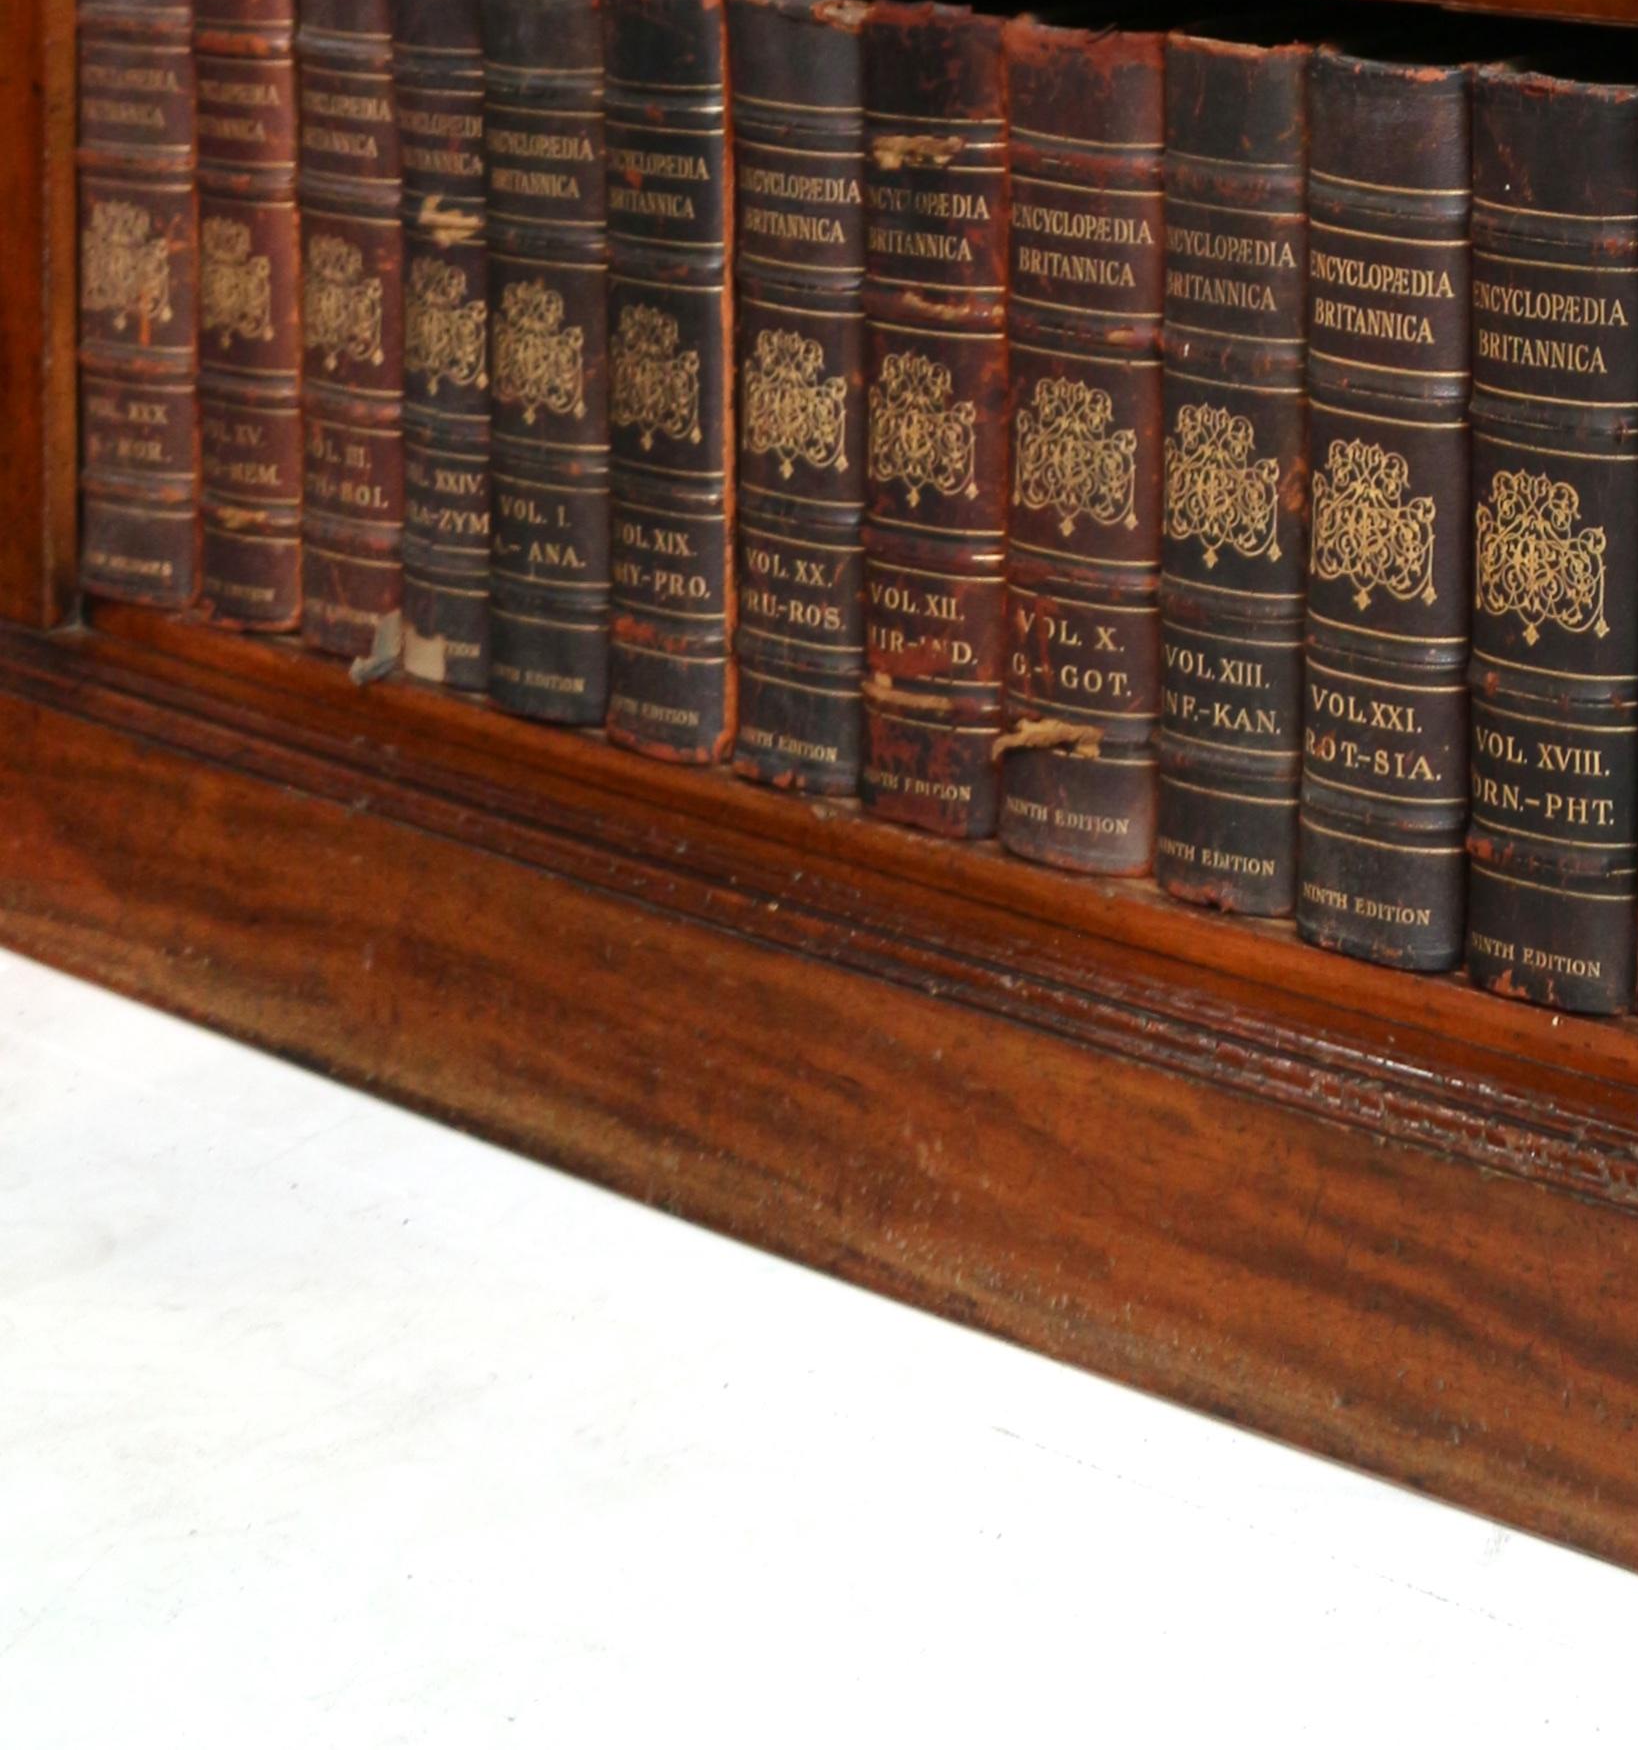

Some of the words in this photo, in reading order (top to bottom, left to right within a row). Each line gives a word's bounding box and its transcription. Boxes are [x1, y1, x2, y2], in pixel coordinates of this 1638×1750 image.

[1012, 202, 1155, 246] ENCYCLOPÆDIA
[1018, 247, 1136, 289] BRITANNICA
[1167, 226, 1297, 269] NCYCLOPÆDIA
[1166, 268, 1278, 312] BRITANNICA
[1310, 249, 1455, 299] ENCYCLOPÆDIA
[1313, 297, 1436, 345] BRITANNICA
[1473, 279, 1629, 328] ENCYCLOPÆDIA
[1477, 330, 1608, 375] BRITANNICA
[653, 528, 698, 558] XIX.
[746, 546, 788, 580] VOL.
[794, 559, 833, 589] XX.
[745, 587, 848, 632] RU.-ROS.
[869, 581, 921, 615] VOL.
[923, 593, 966, 622] XII.
[1093, 626, 1126, 652] X.
[1165, 644, 1216, 682] VOL.
[1219, 657, 1271, 690] XIII.
[1311, 684, 1367, 727] VOL.
[1369, 700, 1423, 735] XXI.
[1475, 724, 1530, 767] VOL.
[1536, 742, 1611, 779] XVIII.
[1054, 808, 1130, 835] EDITION
[1201, 847, 1276, 877] EDITION
[1302, 882, 1349, 912] NINTH
[1354, 893, 1432, 927] EDITION
[1522, 944, 1602, 979] EDITION
